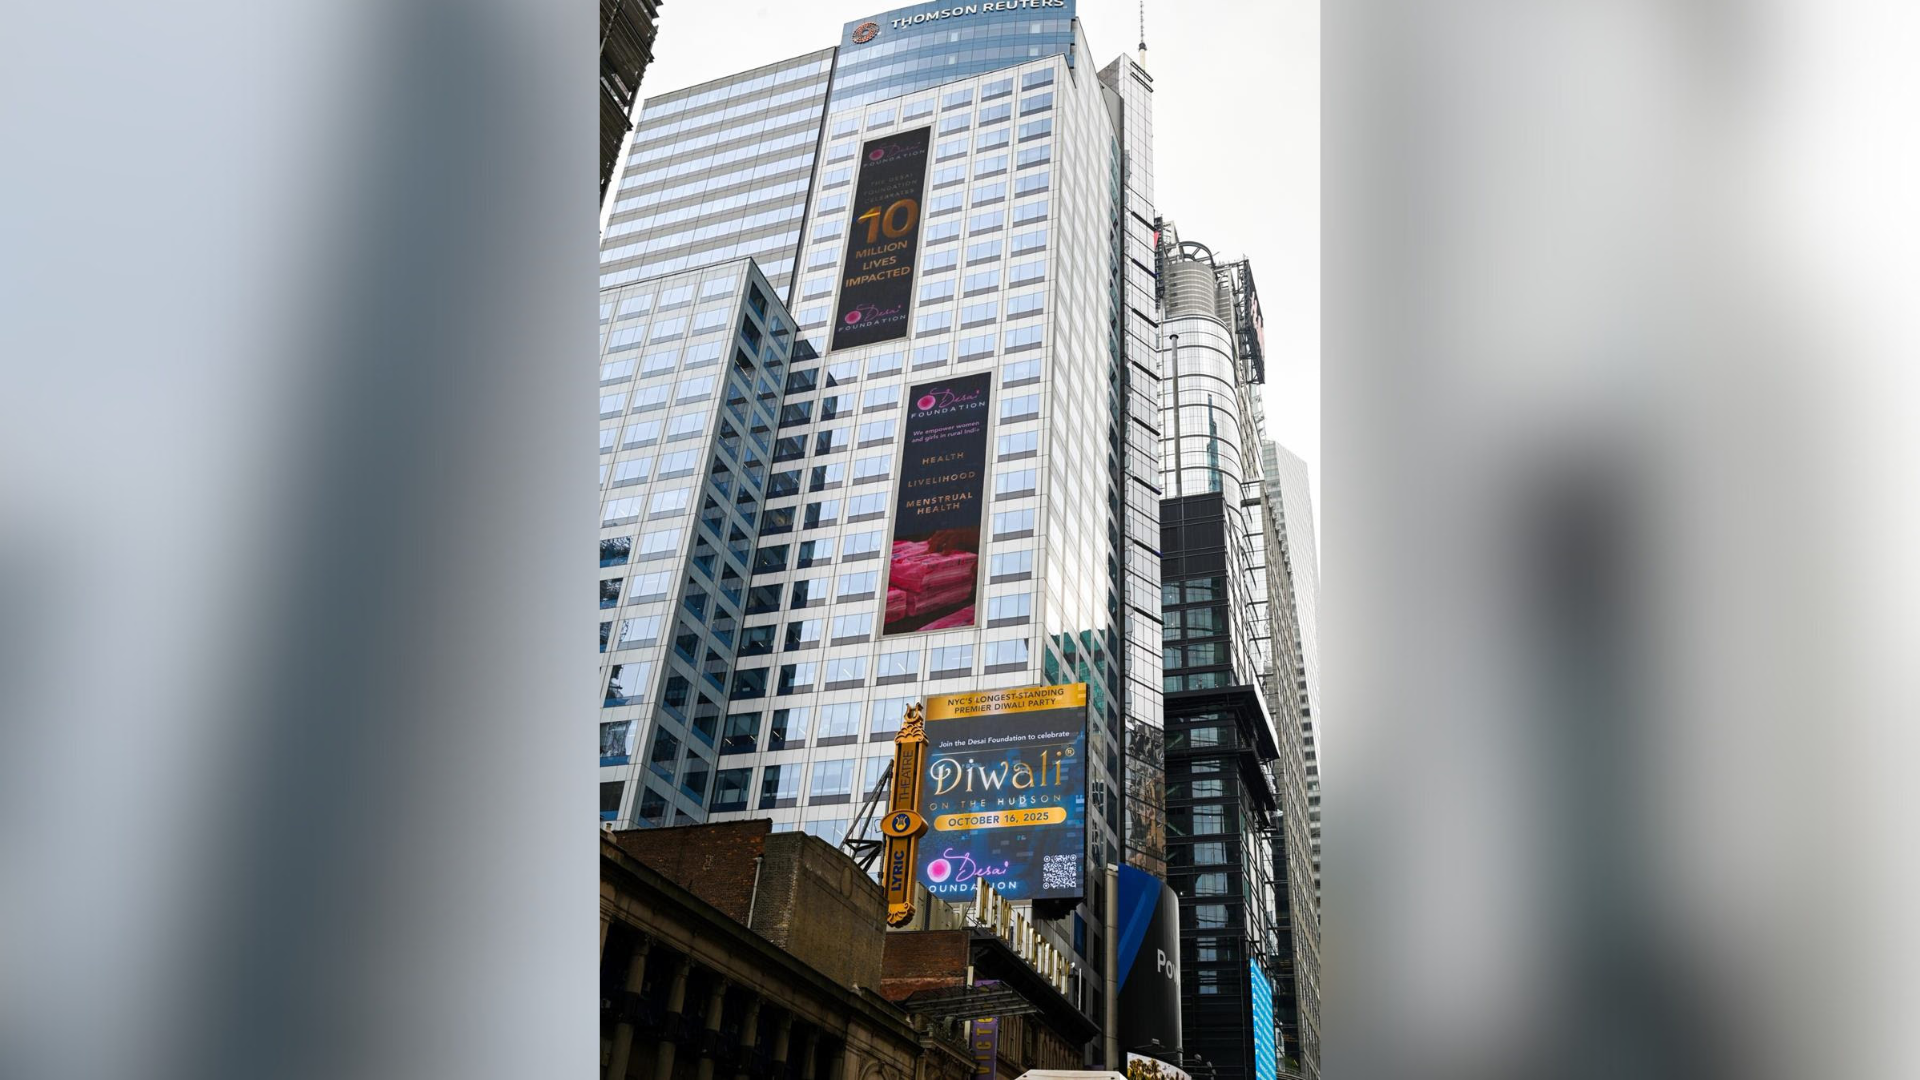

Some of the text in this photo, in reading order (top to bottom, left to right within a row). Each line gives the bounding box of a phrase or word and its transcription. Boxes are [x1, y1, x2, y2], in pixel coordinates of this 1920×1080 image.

[891, 0, 1065, 29] THOMSON REUTERS
[863, 149, 926, 168] FOUNDATION
[858, 198, 919, 244] 10
[855, 240, 908, 259] MILLION
[862, 256, 897, 271] LIVES
[845, 266, 911, 288] IMPACTED
[856, 304, 902, 321] Desai
[838, 314, 907, 332] FOUNDATION
[930, 387, 980, 408] Desai
[910, 401, 986, 419] FOUNDATION
[925, 425, 955, 436] empower
[956, 421, 980, 429] women
[924, 433, 939, 443] girls
[922, 452, 964, 465] HEALTH
[907, 471, 976, 488] LIVELIHOOD
[906, 492, 973, 508] MENSTRUAL
[917, 502, 960, 515] HEALTH
[947, 688, 1065, 706] NYC'S LONGEST-STANDING
[954, 698, 1056, 714] PREMIER DIWALI PARTY
[967, 737, 986, 745] Desai
[988, 734, 1027, 744] Foundation
[1037, 730, 1070, 739] celebrate
[929, 794, 1061, 811] ON THE HUDSON
[891, 750, 913, 891] LYRIC THEATRE
[948, 811, 1049, 827] OCTOBER 16, 2025
[943, 848, 1009, 882] Desai
